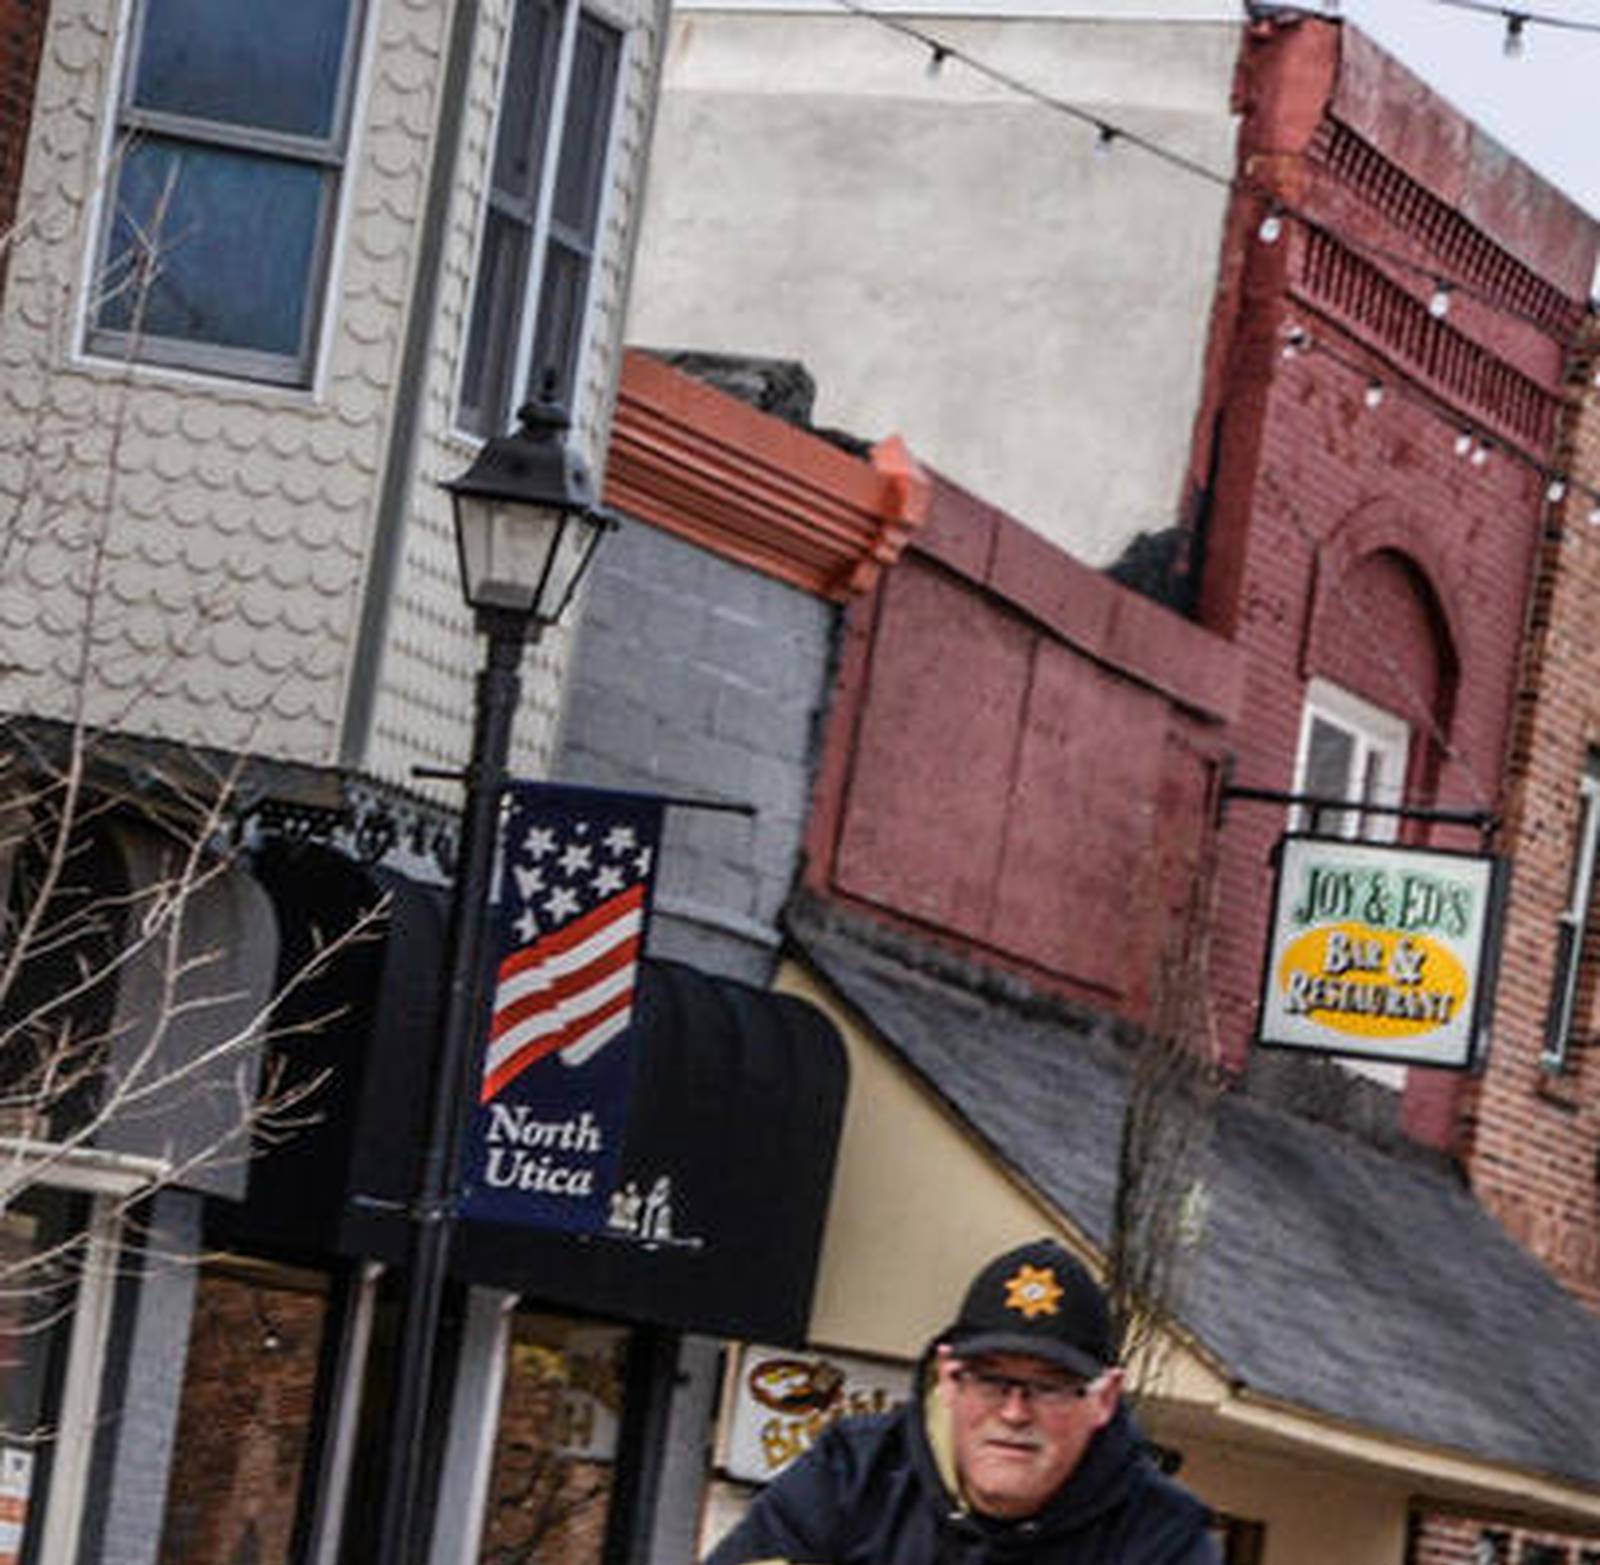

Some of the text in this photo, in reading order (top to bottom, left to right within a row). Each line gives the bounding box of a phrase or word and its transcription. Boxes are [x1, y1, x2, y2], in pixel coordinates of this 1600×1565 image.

[1295, 866, 1357, 925] JOY
[1363, 868, 1391, 925] &
[486, 1103, 602, 1151] North
[486, 1148, 594, 1195] Utica
